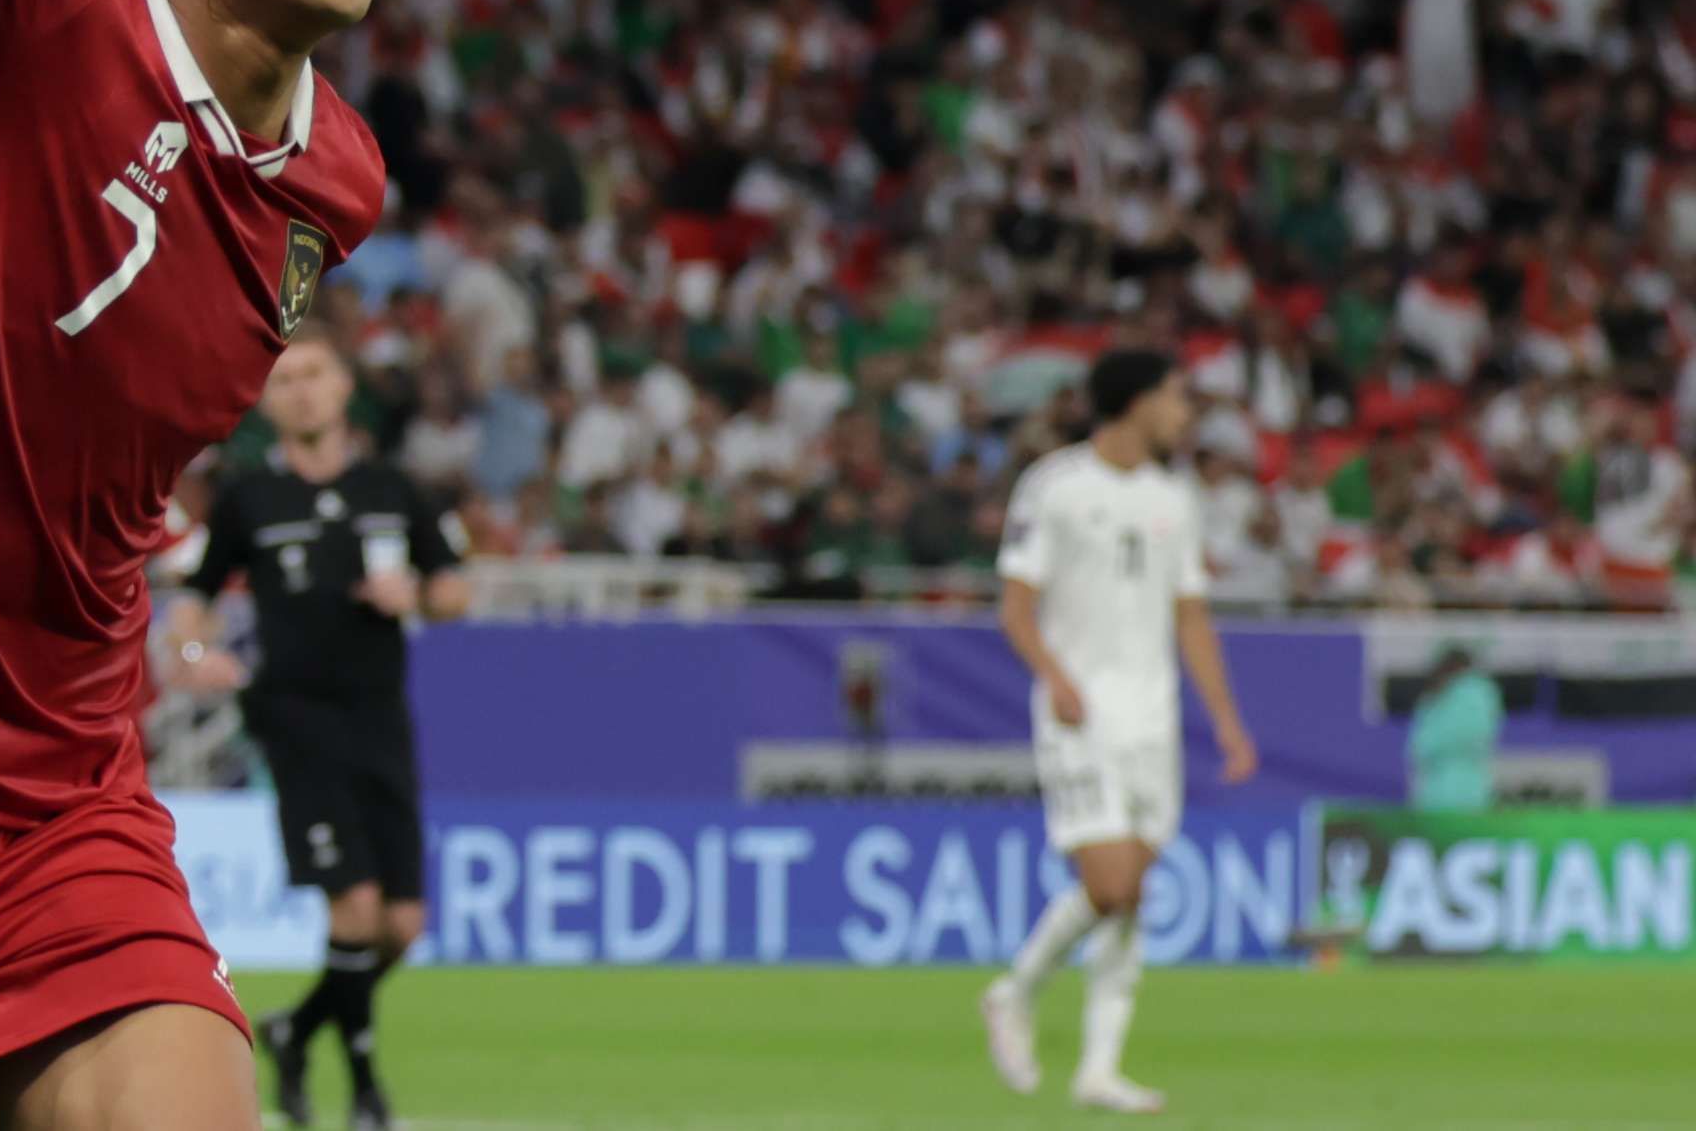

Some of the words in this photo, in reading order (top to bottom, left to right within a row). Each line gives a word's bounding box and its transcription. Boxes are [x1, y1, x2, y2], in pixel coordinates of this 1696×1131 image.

[125, 161, 168, 203] MILLS
[54, 178, 156, 337] 7
[414, 826, 814, 962] REDIT
[837, 824, 1296, 966] SAION
[1366, 836, 1689, 953] ASIAN
